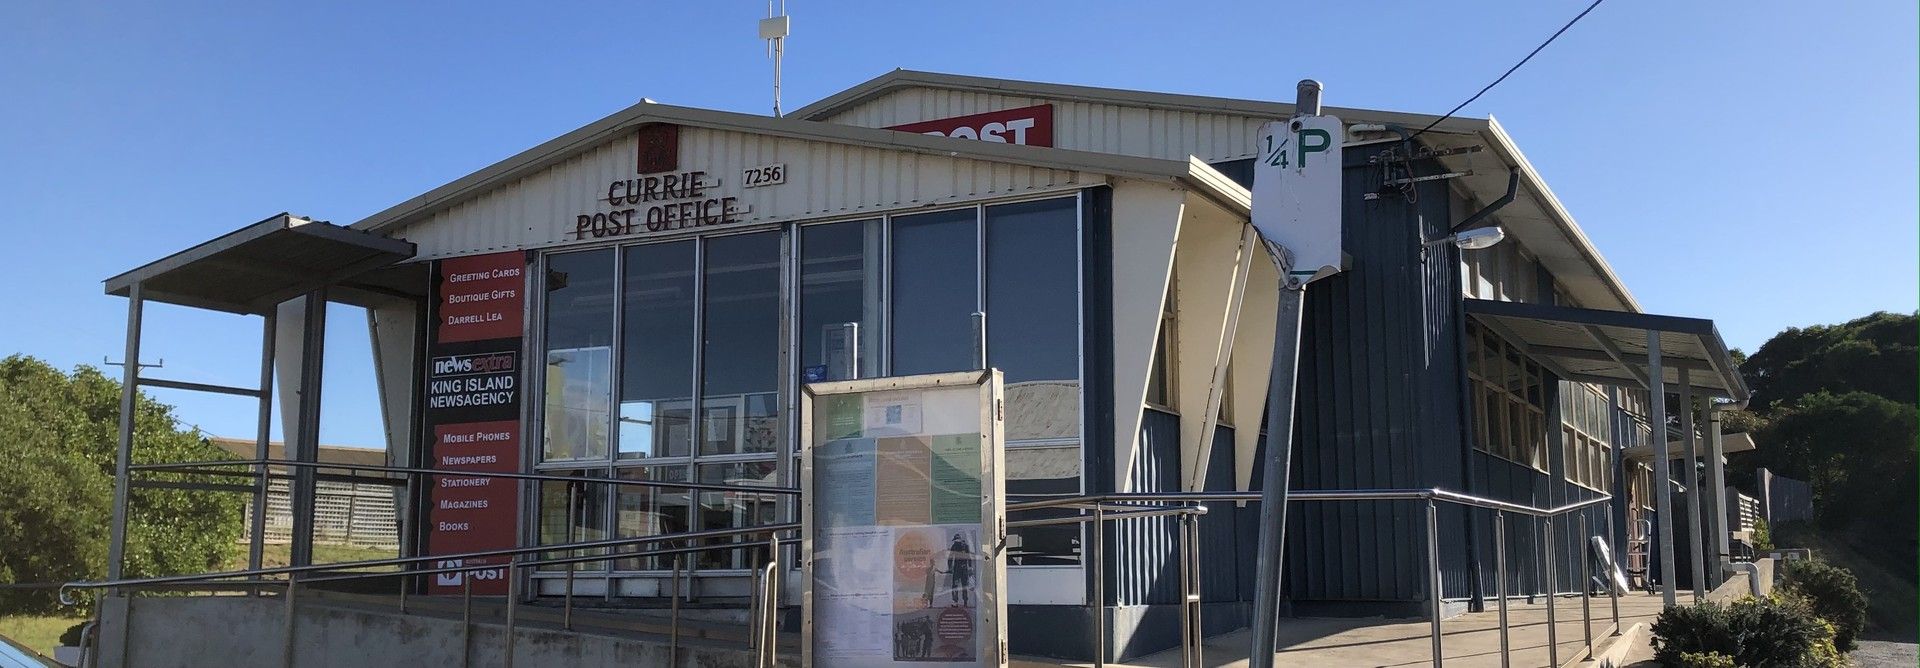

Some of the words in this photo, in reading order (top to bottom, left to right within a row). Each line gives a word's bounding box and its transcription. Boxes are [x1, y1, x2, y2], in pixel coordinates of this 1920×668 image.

[923, 117, 1035, 146] ST
[1298, 128, 1331, 168] P
[608, 171, 705, 206] CURRIE
[744, 166, 781, 185] 7256
[576, 208, 635, 240] POST
[646, 196, 736, 232] OFFICE
[431, 378, 462, 394] KING
[465, 375, 514, 392] ISLAND
[430, 391, 514, 408] NEWSAGENCY
